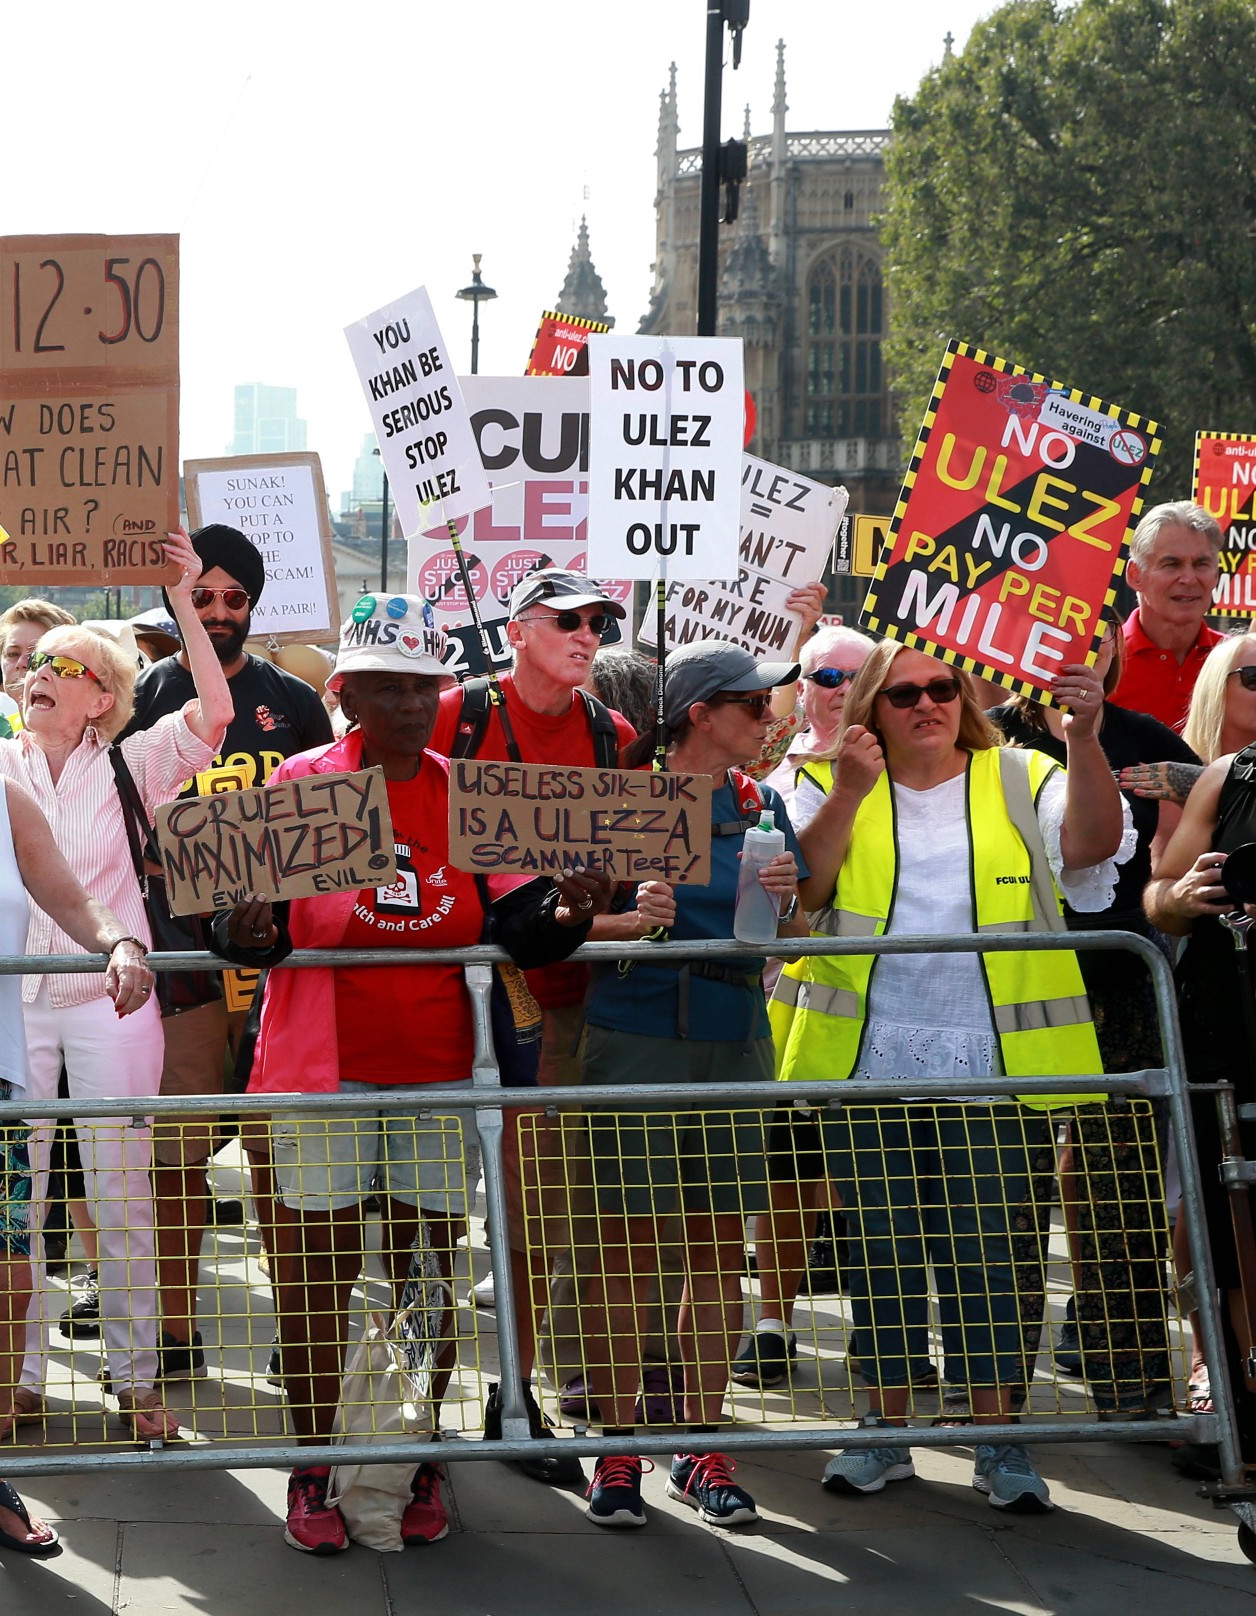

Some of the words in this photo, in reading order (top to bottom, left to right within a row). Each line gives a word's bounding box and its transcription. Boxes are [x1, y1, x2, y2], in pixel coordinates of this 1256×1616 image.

[373, 318, 412, 355] YOU
[368, 359, 418, 402] KHAN
[421, 346, 444, 378] BE
[551, 345, 577, 371] NO
[610, 358, 663, 391] NO
[676, 360, 724, 392] TO
[40, 403, 116, 435] DOES
[382, 386, 453, 438] SERIOUS
[1048, 402, 1102, 433] Havering
[471, 409, 589, 473] CU
[623, 413, 711, 447] ULEZ
[1001, 413, 1076, 470] NO
[1061, 421, 1106, 446] against
[1112, 438, 1144, 458] ULEZ
[59, 445, 163, 488] CLEAN
[405, 431, 448, 470] STOP
[227, 475, 285, 491] SUNAK!
[416, 469, 461, 506] ULEZ
[614, 468, 715, 502] KHAN
[936, 433, 1121, 552] ULEZ
[224, 496, 257, 510] YOU
[261, 493, 294, 506] CAN
[1203, 486, 1256, 521] UL
[240, 515, 269, 527] PUT
[272, 513, 284, 525] A
[273, 531, 294, 544] TO
[626, 523, 701, 555] OUT
[740, 526, 807, 578] AN'T
[839, 516, 849, 561] #together
[972, 513, 1048, 571] NO
[31, 541, 95, 570] LIAR,
[261, 549, 281, 563] HE
[433, 558, 471, 569] JUST
[505, 557, 542, 570] JUST
[1217, 552, 1241, 573] AY
[266, 566, 314, 582] SCAM!
[424, 570, 481, 586] STOP
[496, 570, 531, 586] ST
[904, 531, 992, 589] PAY
[999, 572, 1091, 636] PER
[1212, 573, 1256, 606] MIL
[424, 585, 481, 601] ULEZ
[270, 605, 279, 616] A
[664, 580, 710, 614] FOR
[710, 597, 745, 626] MY
[741, 607, 793, 651] MUM
[897, 569, 1073, 682] MILE
[344, 619, 400, 647] NHS
[457, 762, 585, 801] USELESS
[592, 773, 698, 803] SIK-DIK
[167, 775, 373, 839] CRUELTY
[459, 806, 487, 838] IS
[495, 808, 518, 843] A
[534, 806, 693, 854] ULEZZA
[1018, 876, 1031, 884] UL
[377, 919, 404, 932] and
[409, 913, 443, 931] Care
[436, 895, 456, 916] bill
